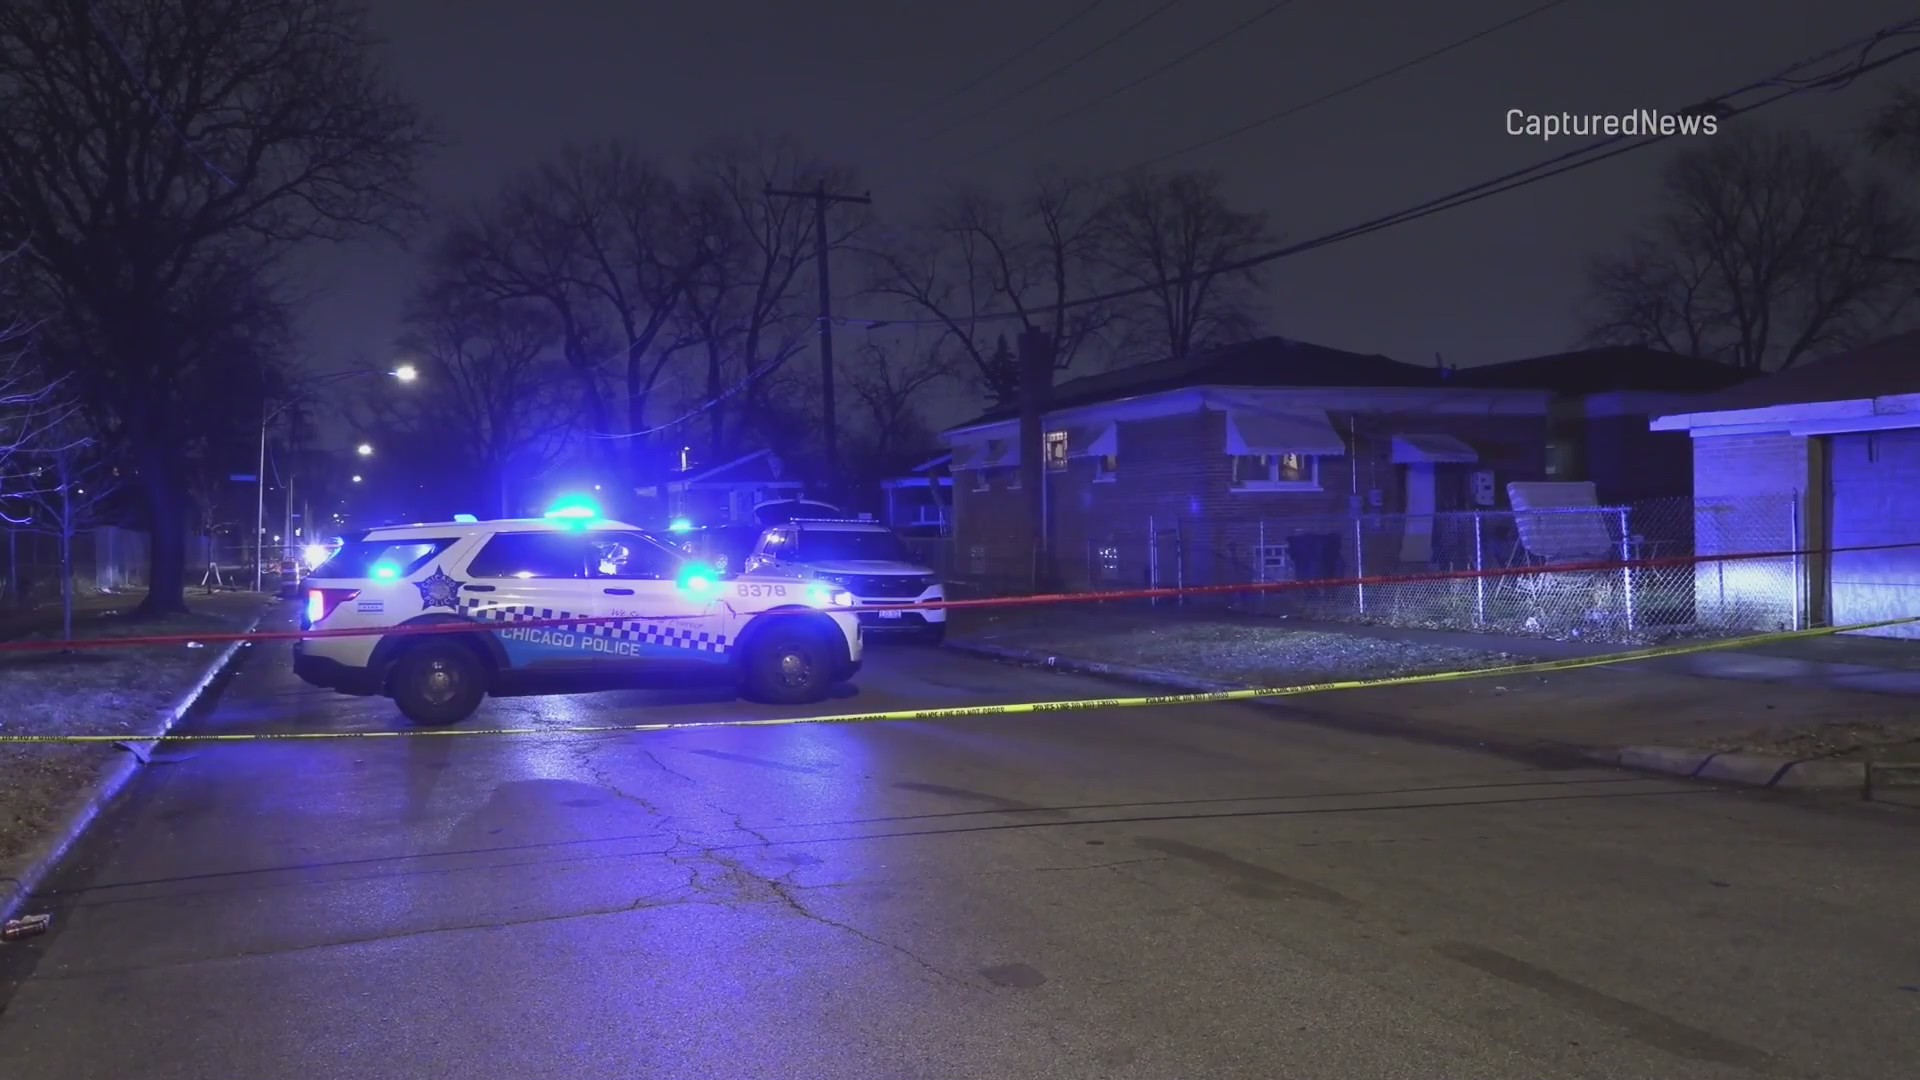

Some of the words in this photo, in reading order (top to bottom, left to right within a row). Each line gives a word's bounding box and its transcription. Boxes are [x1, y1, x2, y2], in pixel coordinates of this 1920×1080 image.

[737, 584, 787, 597] 8378
[501, 626, 575, 648] CHICAGO
[580, 636, 642, 656] POLICE
